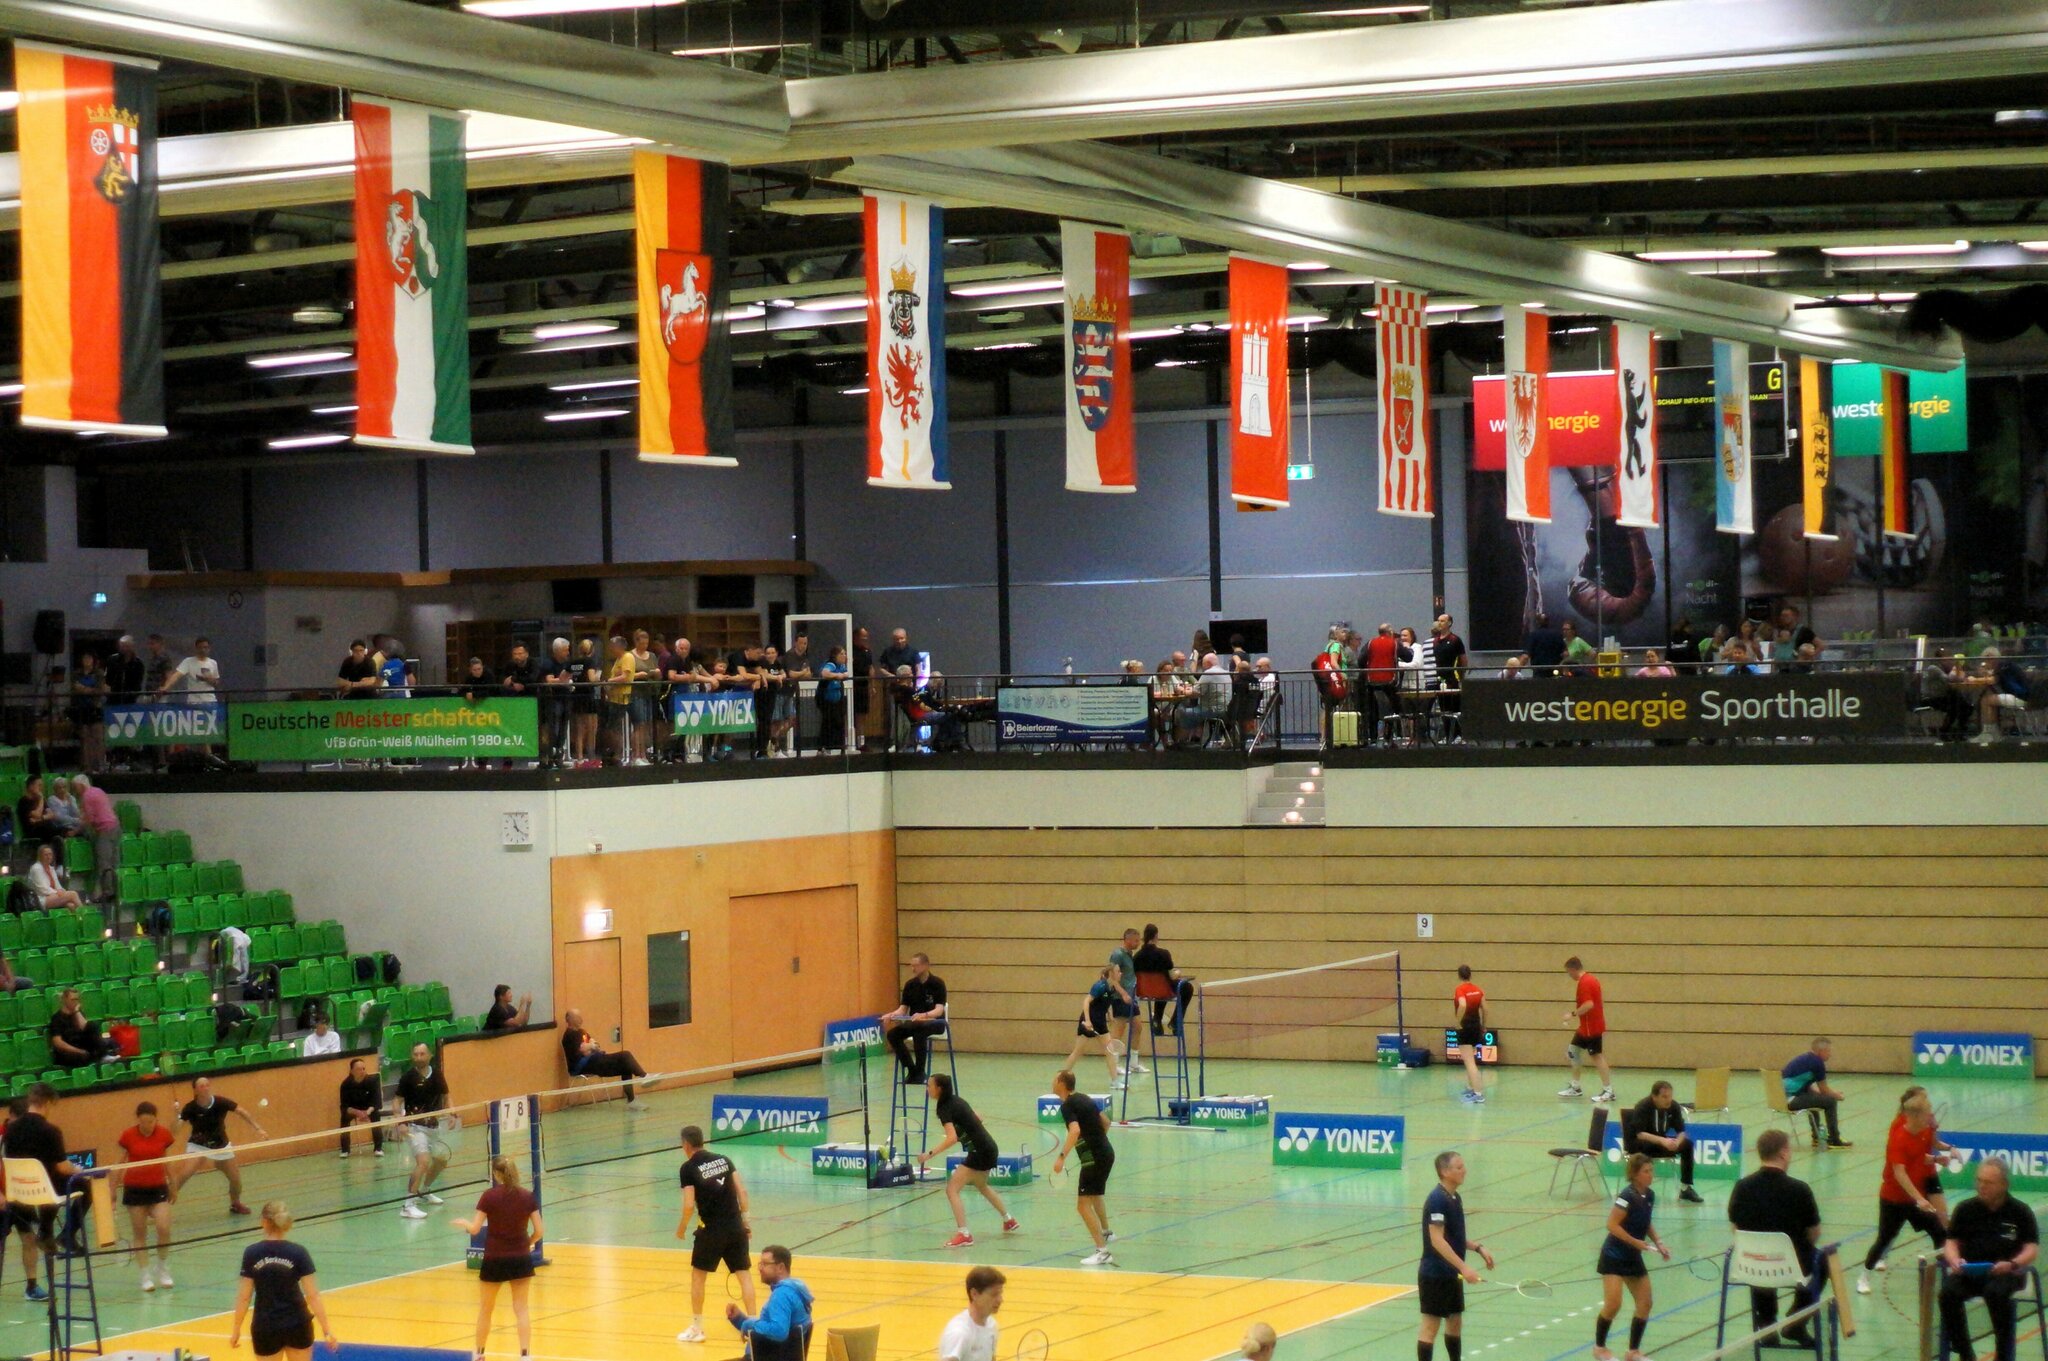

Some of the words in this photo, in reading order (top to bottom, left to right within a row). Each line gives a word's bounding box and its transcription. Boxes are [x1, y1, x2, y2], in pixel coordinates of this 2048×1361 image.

[1767, 368, 1782, 389] G
[1832, 395, 1951, 418] westergie
[241, 711, 329, 730] Deutsche
[335, 707, 500, 728] Meisterschaften
[708, 699, 754, 726] YONEX
[1504, 692, 1687, 727] westenergie
[1700, 689, 1860, 726] Sporthalle
[150, 709, 219, 736] YONEX
[325, 737, 347, 748] VfB
[349, 734, 412, 748] Grün-Weiß
[415, 734, 467, 746] Mülheim
[471, 734, 501, 746] 1980
[1421, 917, 1428, 928] 9
[850, 1026, 883, 1048] YONEX
[1484, 1032, 1494, 1046] 9
[1486, 1048, 1493, 1059] 7
[1959, 1044, 2024, 1066] YONEX
[504, 1103, 510, 1118] 7
[517, 1101, 523, 1116] 8
[1214, 1107, 1246, 1119] YONEX
[757, 1109, 820, 1134] YONEX
[1324, 1128, 1394, 1154] YONEX
[835, 1156, 867, 1169] YONEX
[1693, 1140, 1733, 1166] NEX
[702, 1164, 729, 1179] GERMANY
[989, 1165, 1011, 1177] NEX
